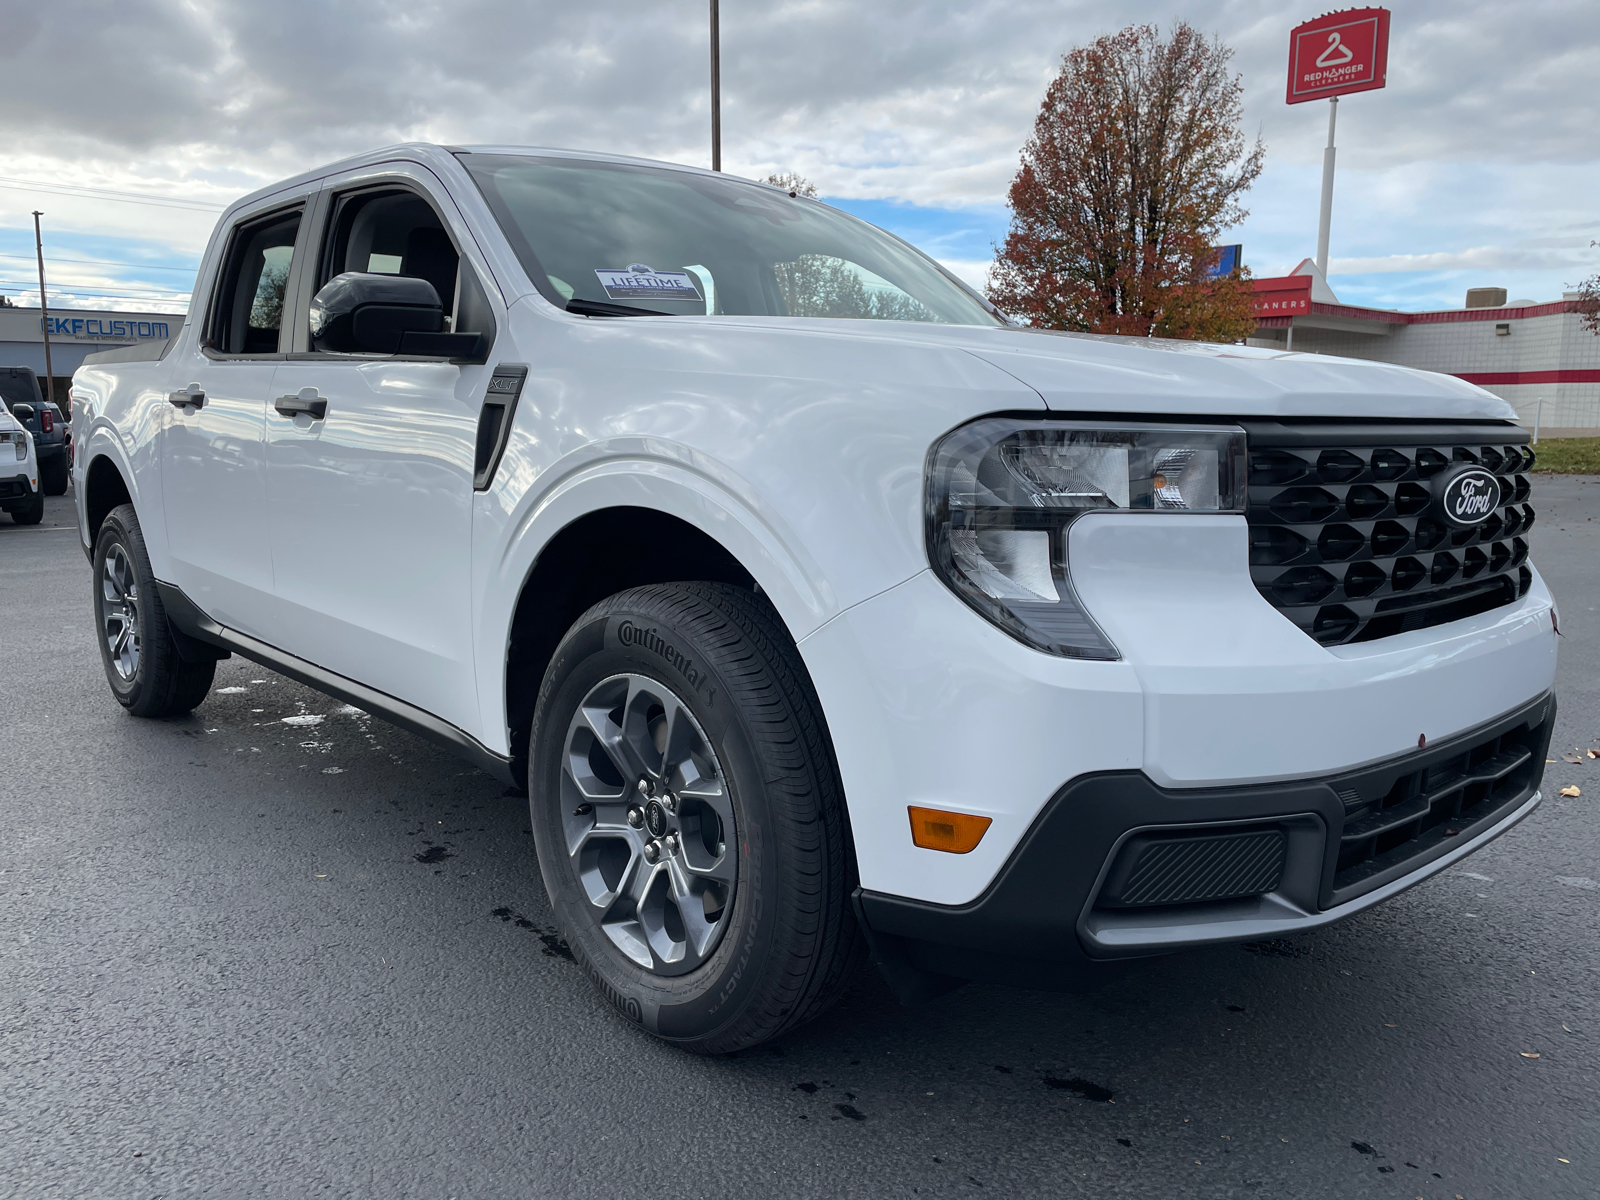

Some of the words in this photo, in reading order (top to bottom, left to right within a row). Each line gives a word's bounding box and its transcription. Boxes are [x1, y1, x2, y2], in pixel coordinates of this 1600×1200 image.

[1304, 72, 1322, 82] RED
[1310, 74, 1355, 87] CLEANERS
[611, 277, 684, 288] LIFETIME
[488, 379, 518, 391] XLT
[1455, 478, 1492, 516] Ford
[617, 619, 708, 693] Continental
[717, 823, 765, 1006] PROCONTACT
